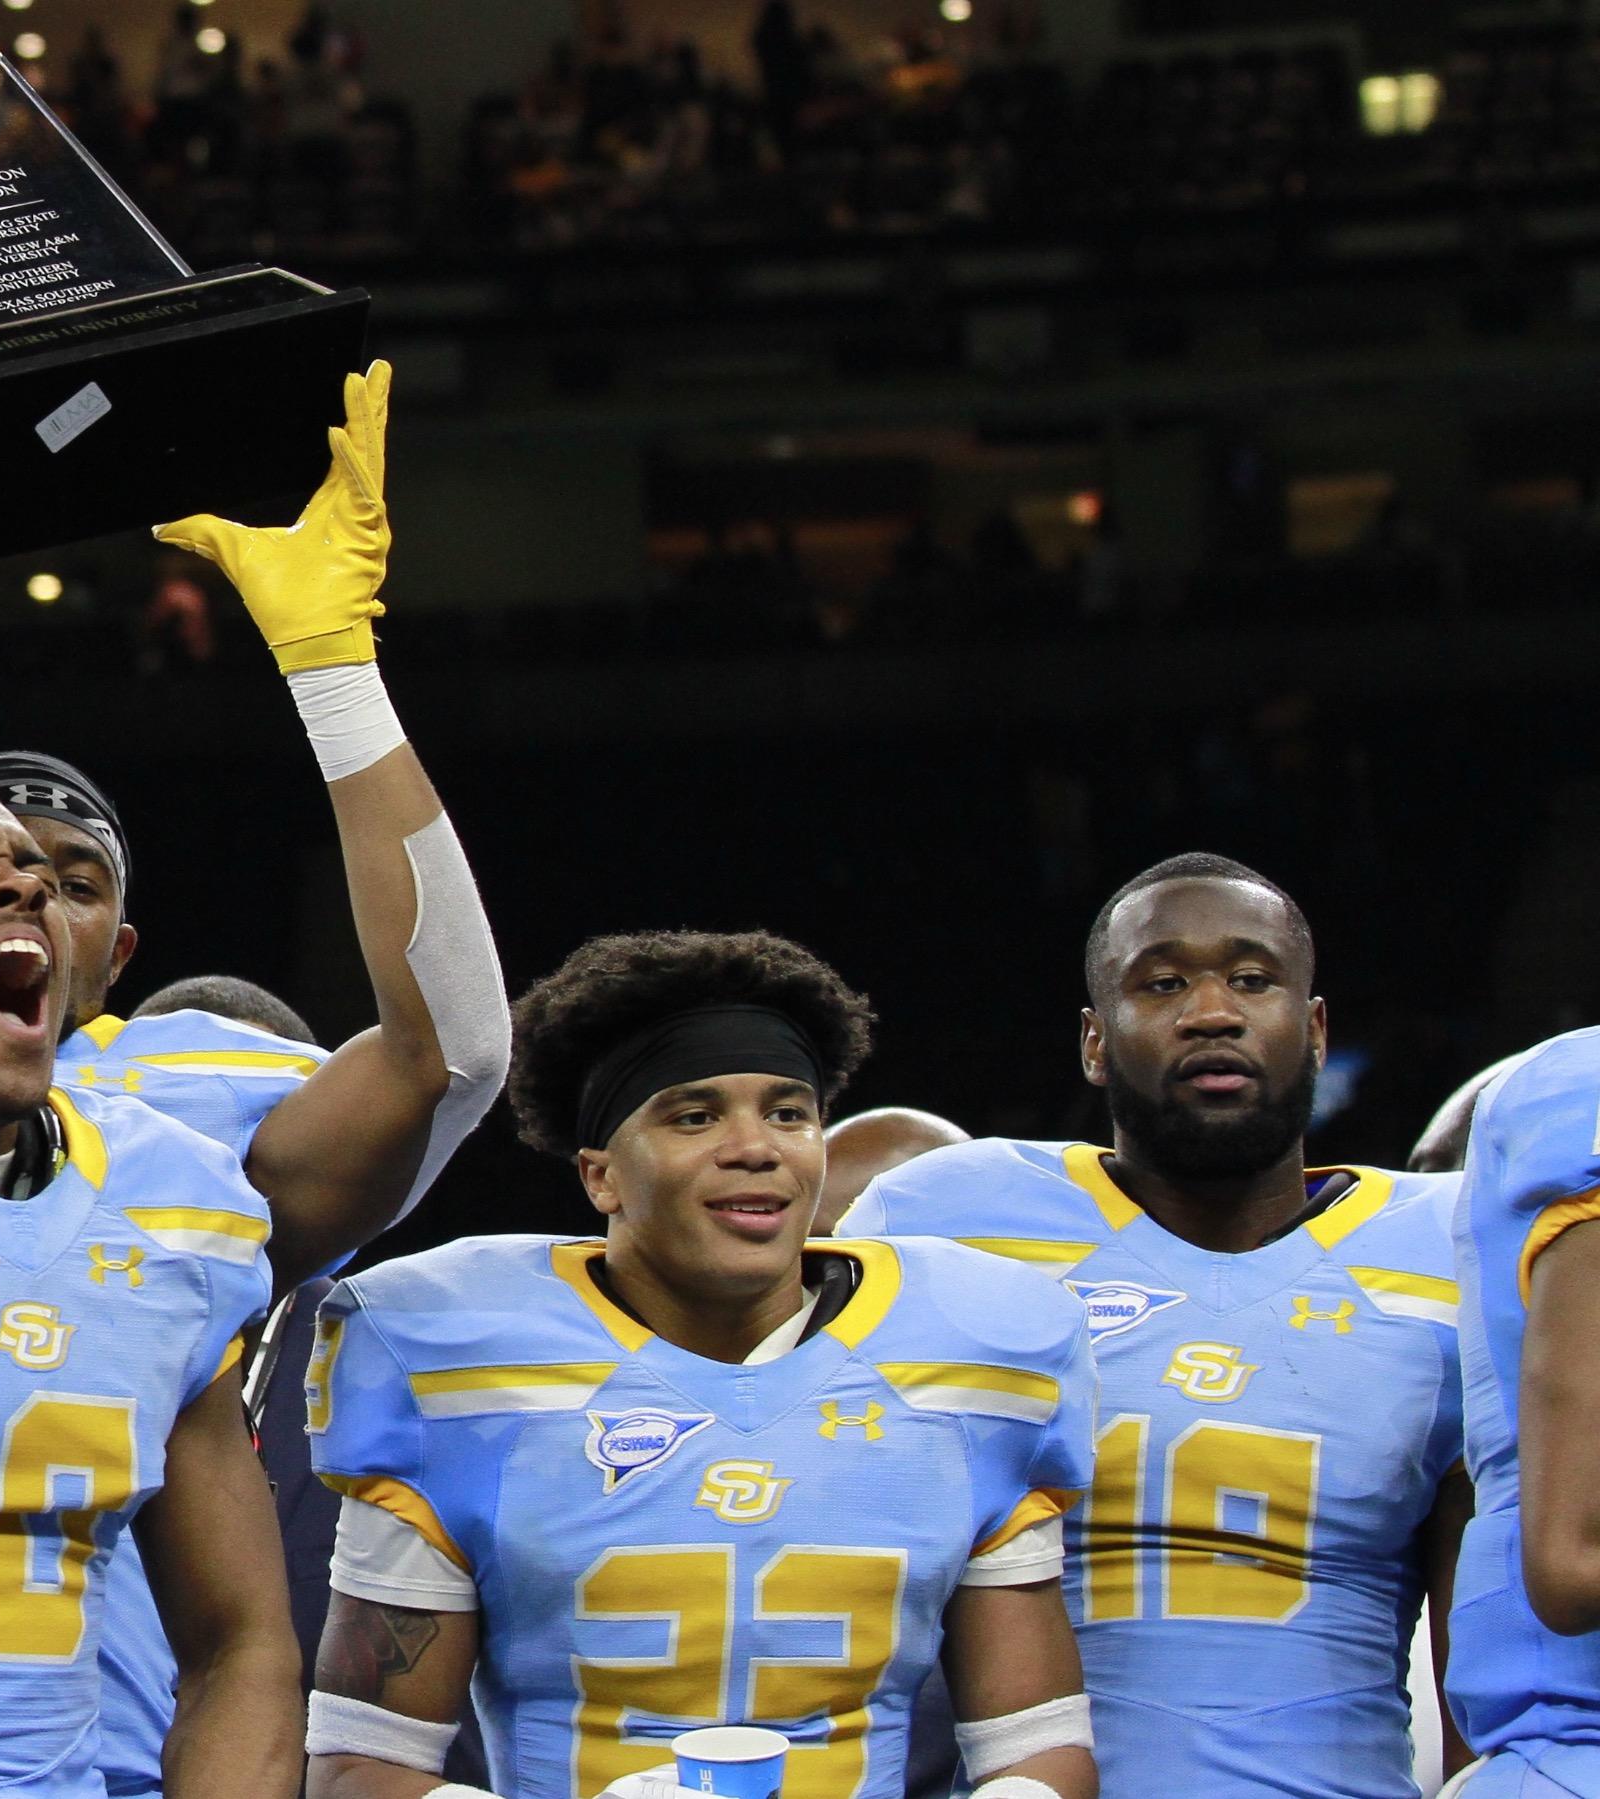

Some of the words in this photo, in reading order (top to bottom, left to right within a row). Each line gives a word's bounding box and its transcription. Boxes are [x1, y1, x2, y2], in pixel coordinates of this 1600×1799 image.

[14, 210, 60, 227] STATE
[1, 240, 41, 255] VIEW
[44, 233, 80, 248] A&M
[34, 279, 116, 302] SOUTHERN
[60, 300, 201, 337] UNIVERSITY
[1091, 1304, 1137, 1318] SWAC
[1164, 1342, 1255, 1401] SU
[697, 1460, 789, 1522] SU
[570, 1543, 908, 1799] 23
